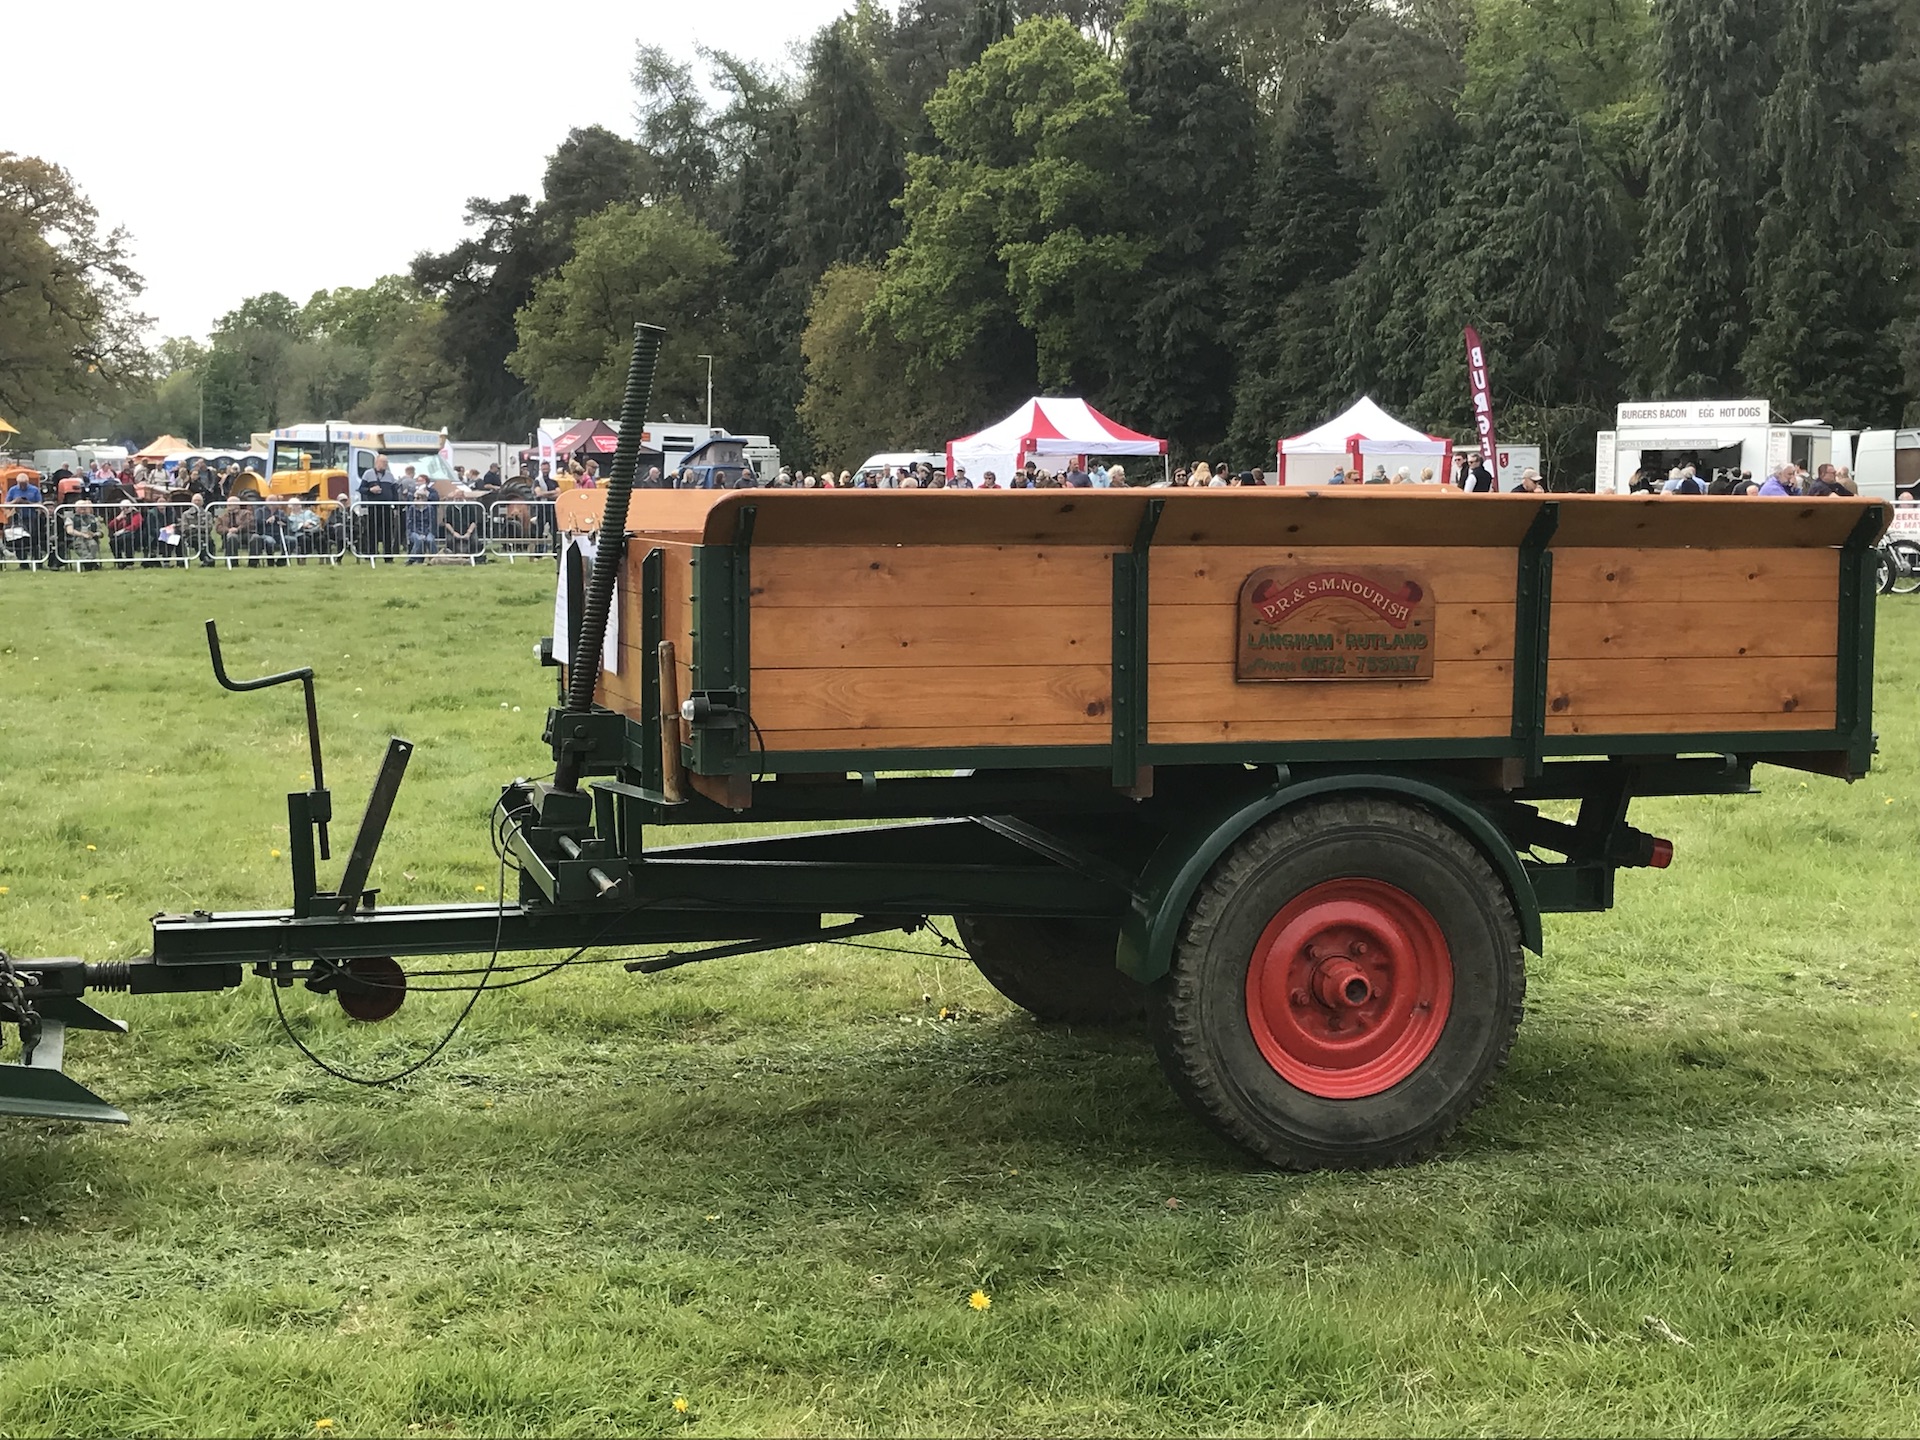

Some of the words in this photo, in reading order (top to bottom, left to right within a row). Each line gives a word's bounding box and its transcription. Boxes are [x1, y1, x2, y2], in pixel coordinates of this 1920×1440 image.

[1621, 409, 1658, 419] BURGERS
[1659, 408, 1687, 419] BACON
[1698, 408, 1715, 418] EGG
[1719, 407, 1736, 417] HOT
[1737, 406, 1761, 417] DOGS
[1896, 513, 1920, 521] EEKE
[1247, 633, 1334, 650] LANGHAM
[1345, 633, 1428, 650] RUTLAND
